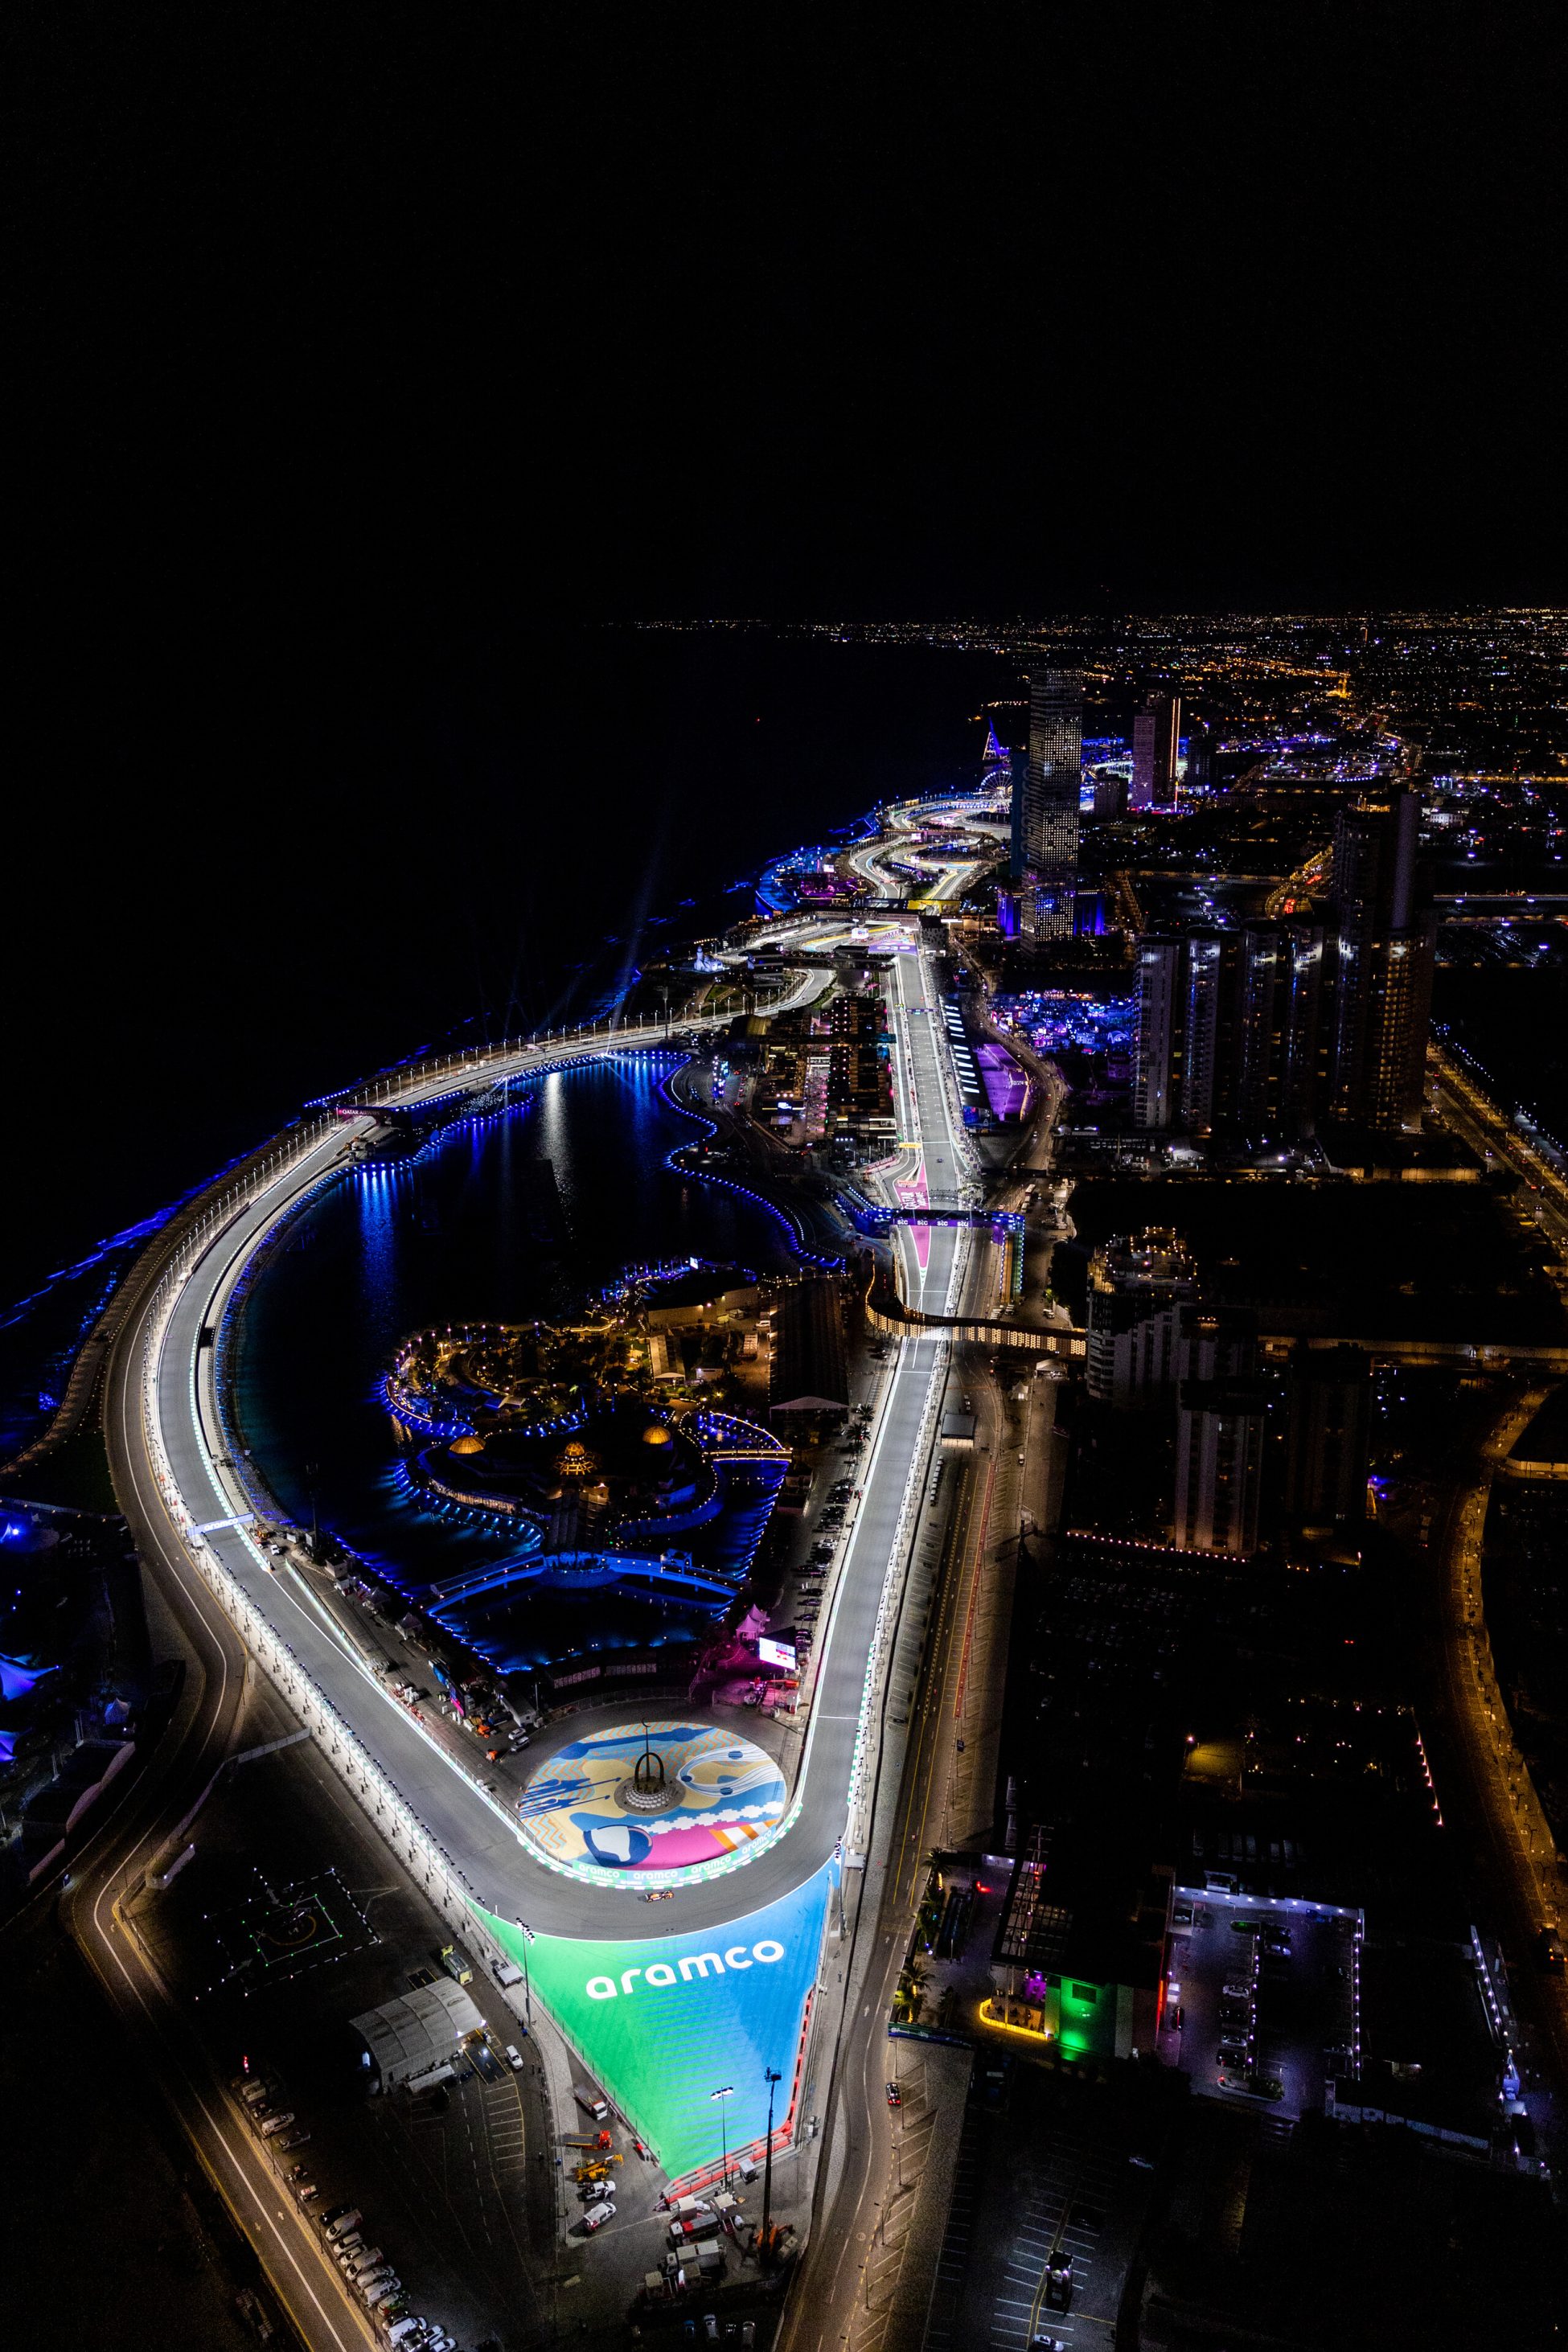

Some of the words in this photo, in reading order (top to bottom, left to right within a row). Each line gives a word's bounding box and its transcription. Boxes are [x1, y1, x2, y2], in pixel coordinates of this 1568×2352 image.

[204, 1518, 239, 1531] aramco
[741, 1829, 772, 1854] aramco
[579, 1864, 620, 1878] aramco
[692, 1855, 732, 1874] aramco
[633, 1870, 679, 1880] aramco
[585, 1940, 785, 2000] aramco
